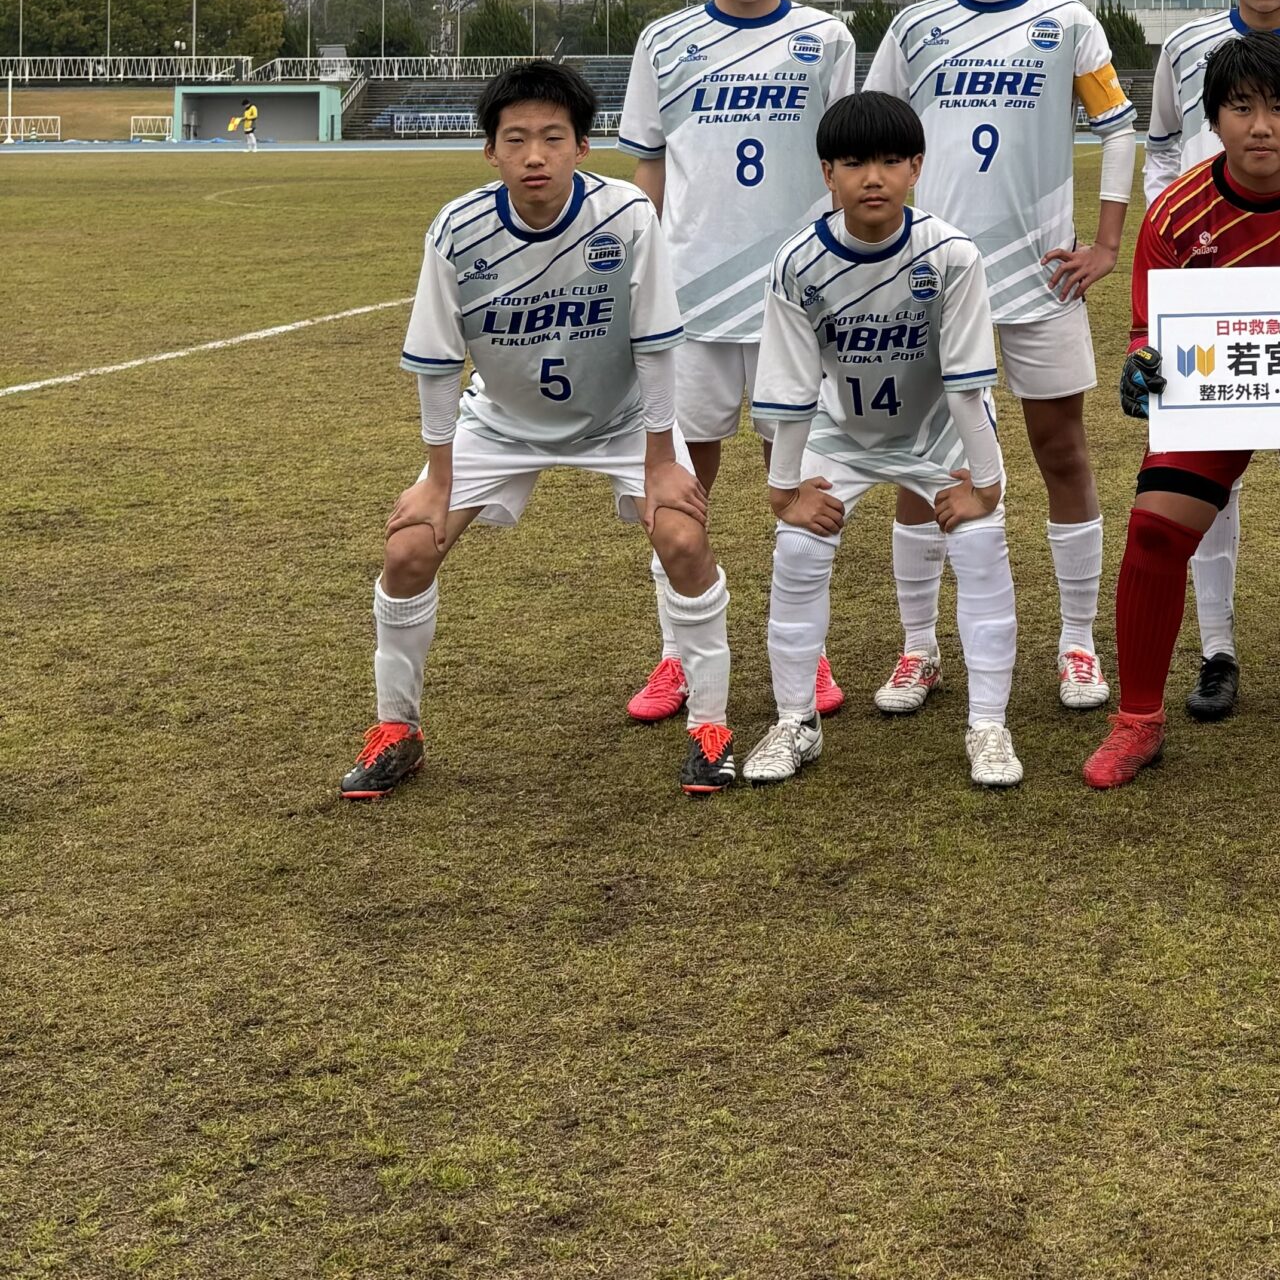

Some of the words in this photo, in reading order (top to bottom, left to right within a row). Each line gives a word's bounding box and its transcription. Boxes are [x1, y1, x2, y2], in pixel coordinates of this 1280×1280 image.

[942, 58, 1007, 68] FOOTBALL
[1011, 58, 1044, 68] CLUB
[703, 72, 769, 83] FOOTBALL
[773, 71, 807, 81] CLUB
[934, 71, 1047, 97] LIBRE
[691, 85, 809, 112] LIBRE
[939, 99, 997, 109] FUKUOKA
[1003, 99, 1036, 109] 2016
[698, 112, 761, 124] FUKUOKA
[768, 112, 801, 122] 2016
[972, 123, 999, 173] 9
[736, 138, 764, 187] 8
[588, 249, 622, 260] LIBRE
[491, 287, 568, 307] FOOTBALL
[571, 283, 608, 297] CLUB
[482, 297, 615, 335] LIBRE
[895, 310, 926, 322] CLUB
[491, 332, 561, 346] FUKUOKA
[568, 326, 607, 341] 2016
[890, 349, 925, 361] 2016
[539, 358, 572, 402] 5
[846, 376, 902, 417] 14
